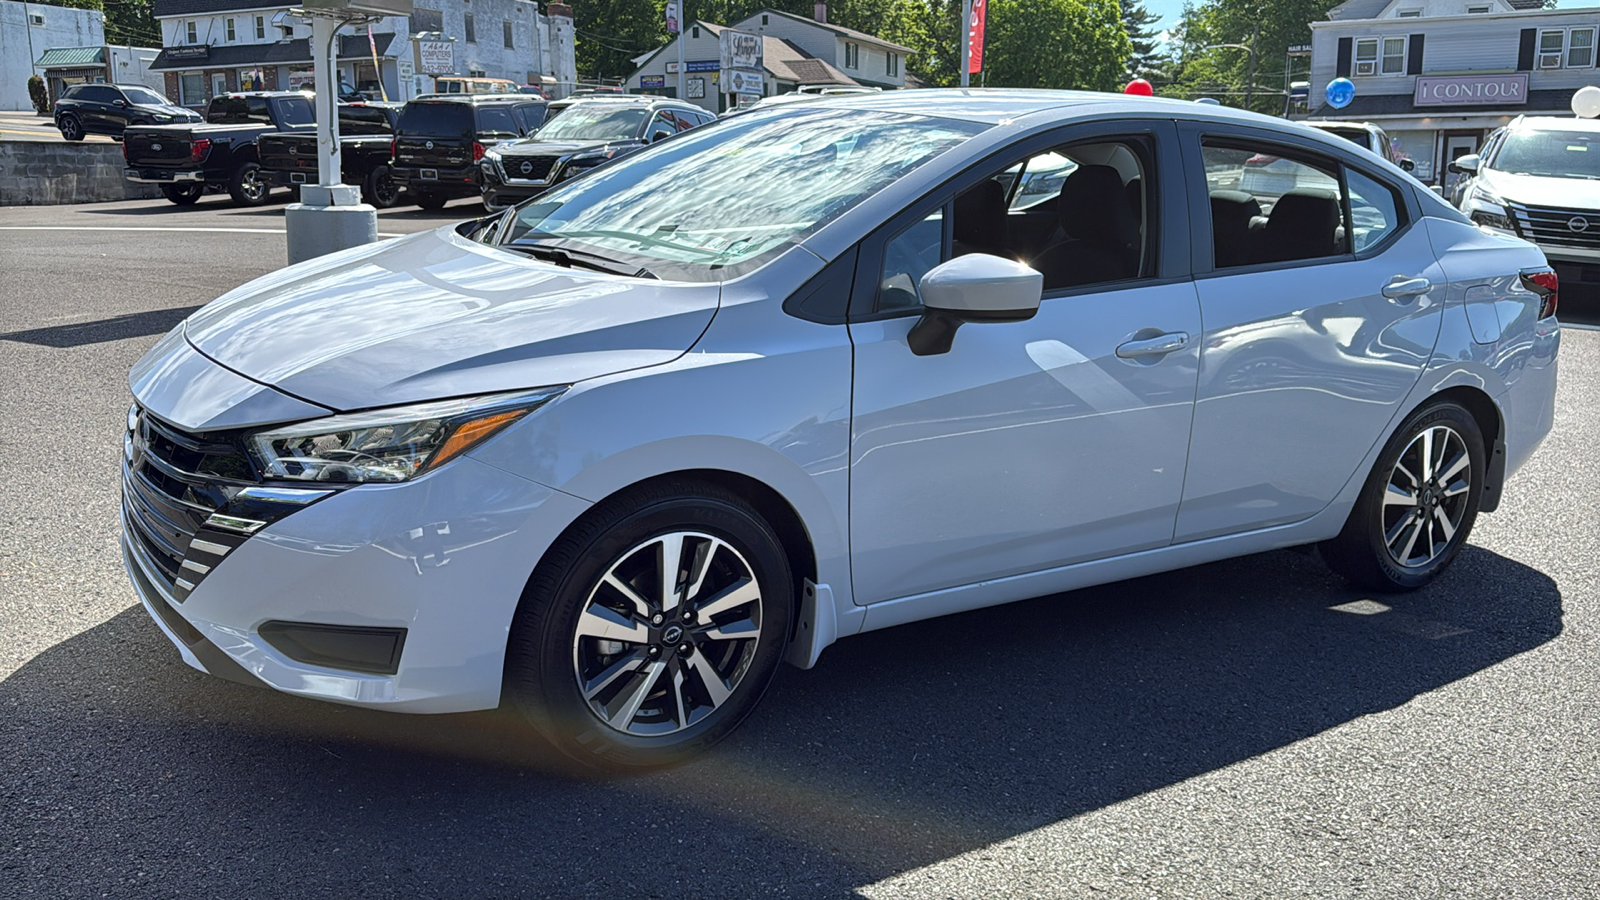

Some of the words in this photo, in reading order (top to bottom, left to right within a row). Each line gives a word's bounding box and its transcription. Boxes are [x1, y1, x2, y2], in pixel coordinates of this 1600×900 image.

[422, 50, 451, 58] COMPUTERS
[422, 65, 454, 73] 942-9700
[1423, 82, 1428, 98] i
[1433, 82, 1519, 98] CONTOUR
